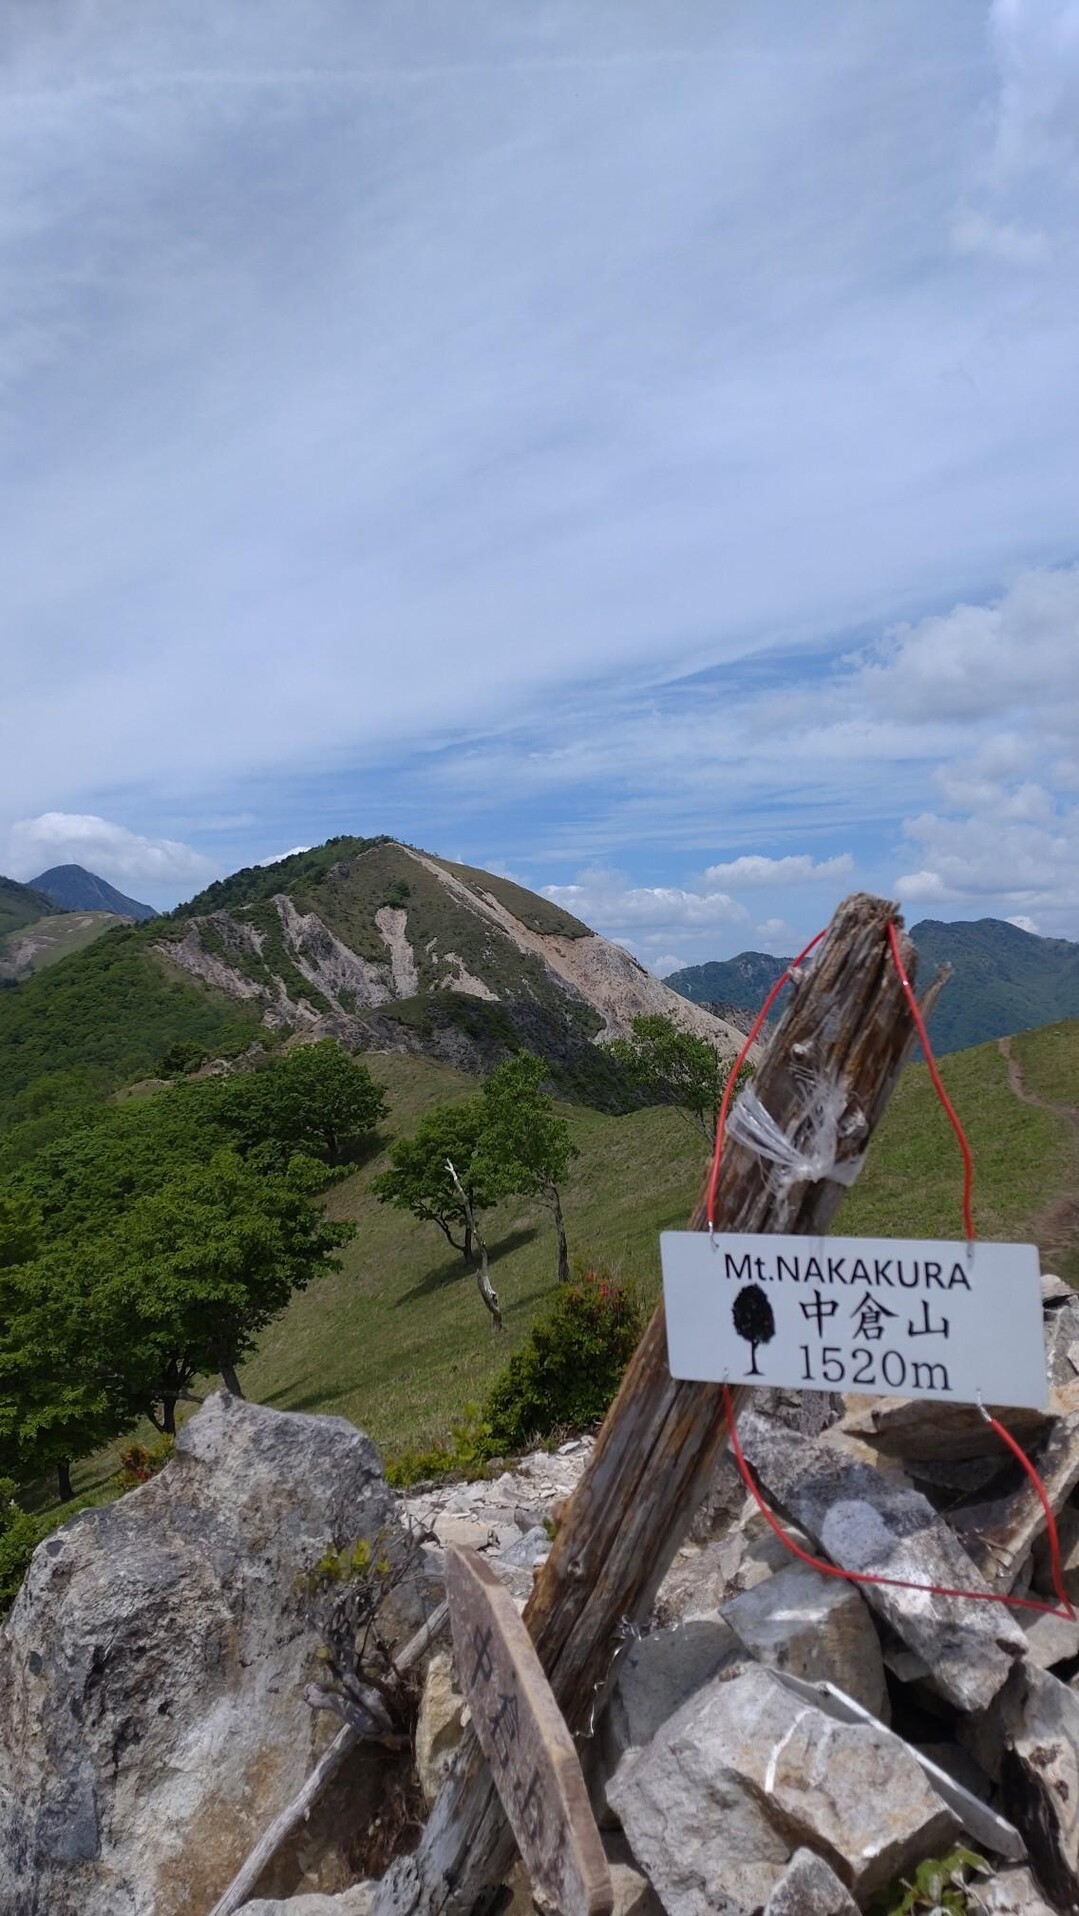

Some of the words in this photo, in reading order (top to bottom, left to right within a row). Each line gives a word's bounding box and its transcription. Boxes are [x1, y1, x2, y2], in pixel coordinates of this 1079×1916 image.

[724, 1254, 972, 1291] Mt.NAKAKURA
[799, 1289, 950, 1341] 中倉山
[800, 1344, 953, 1391] 1520m
